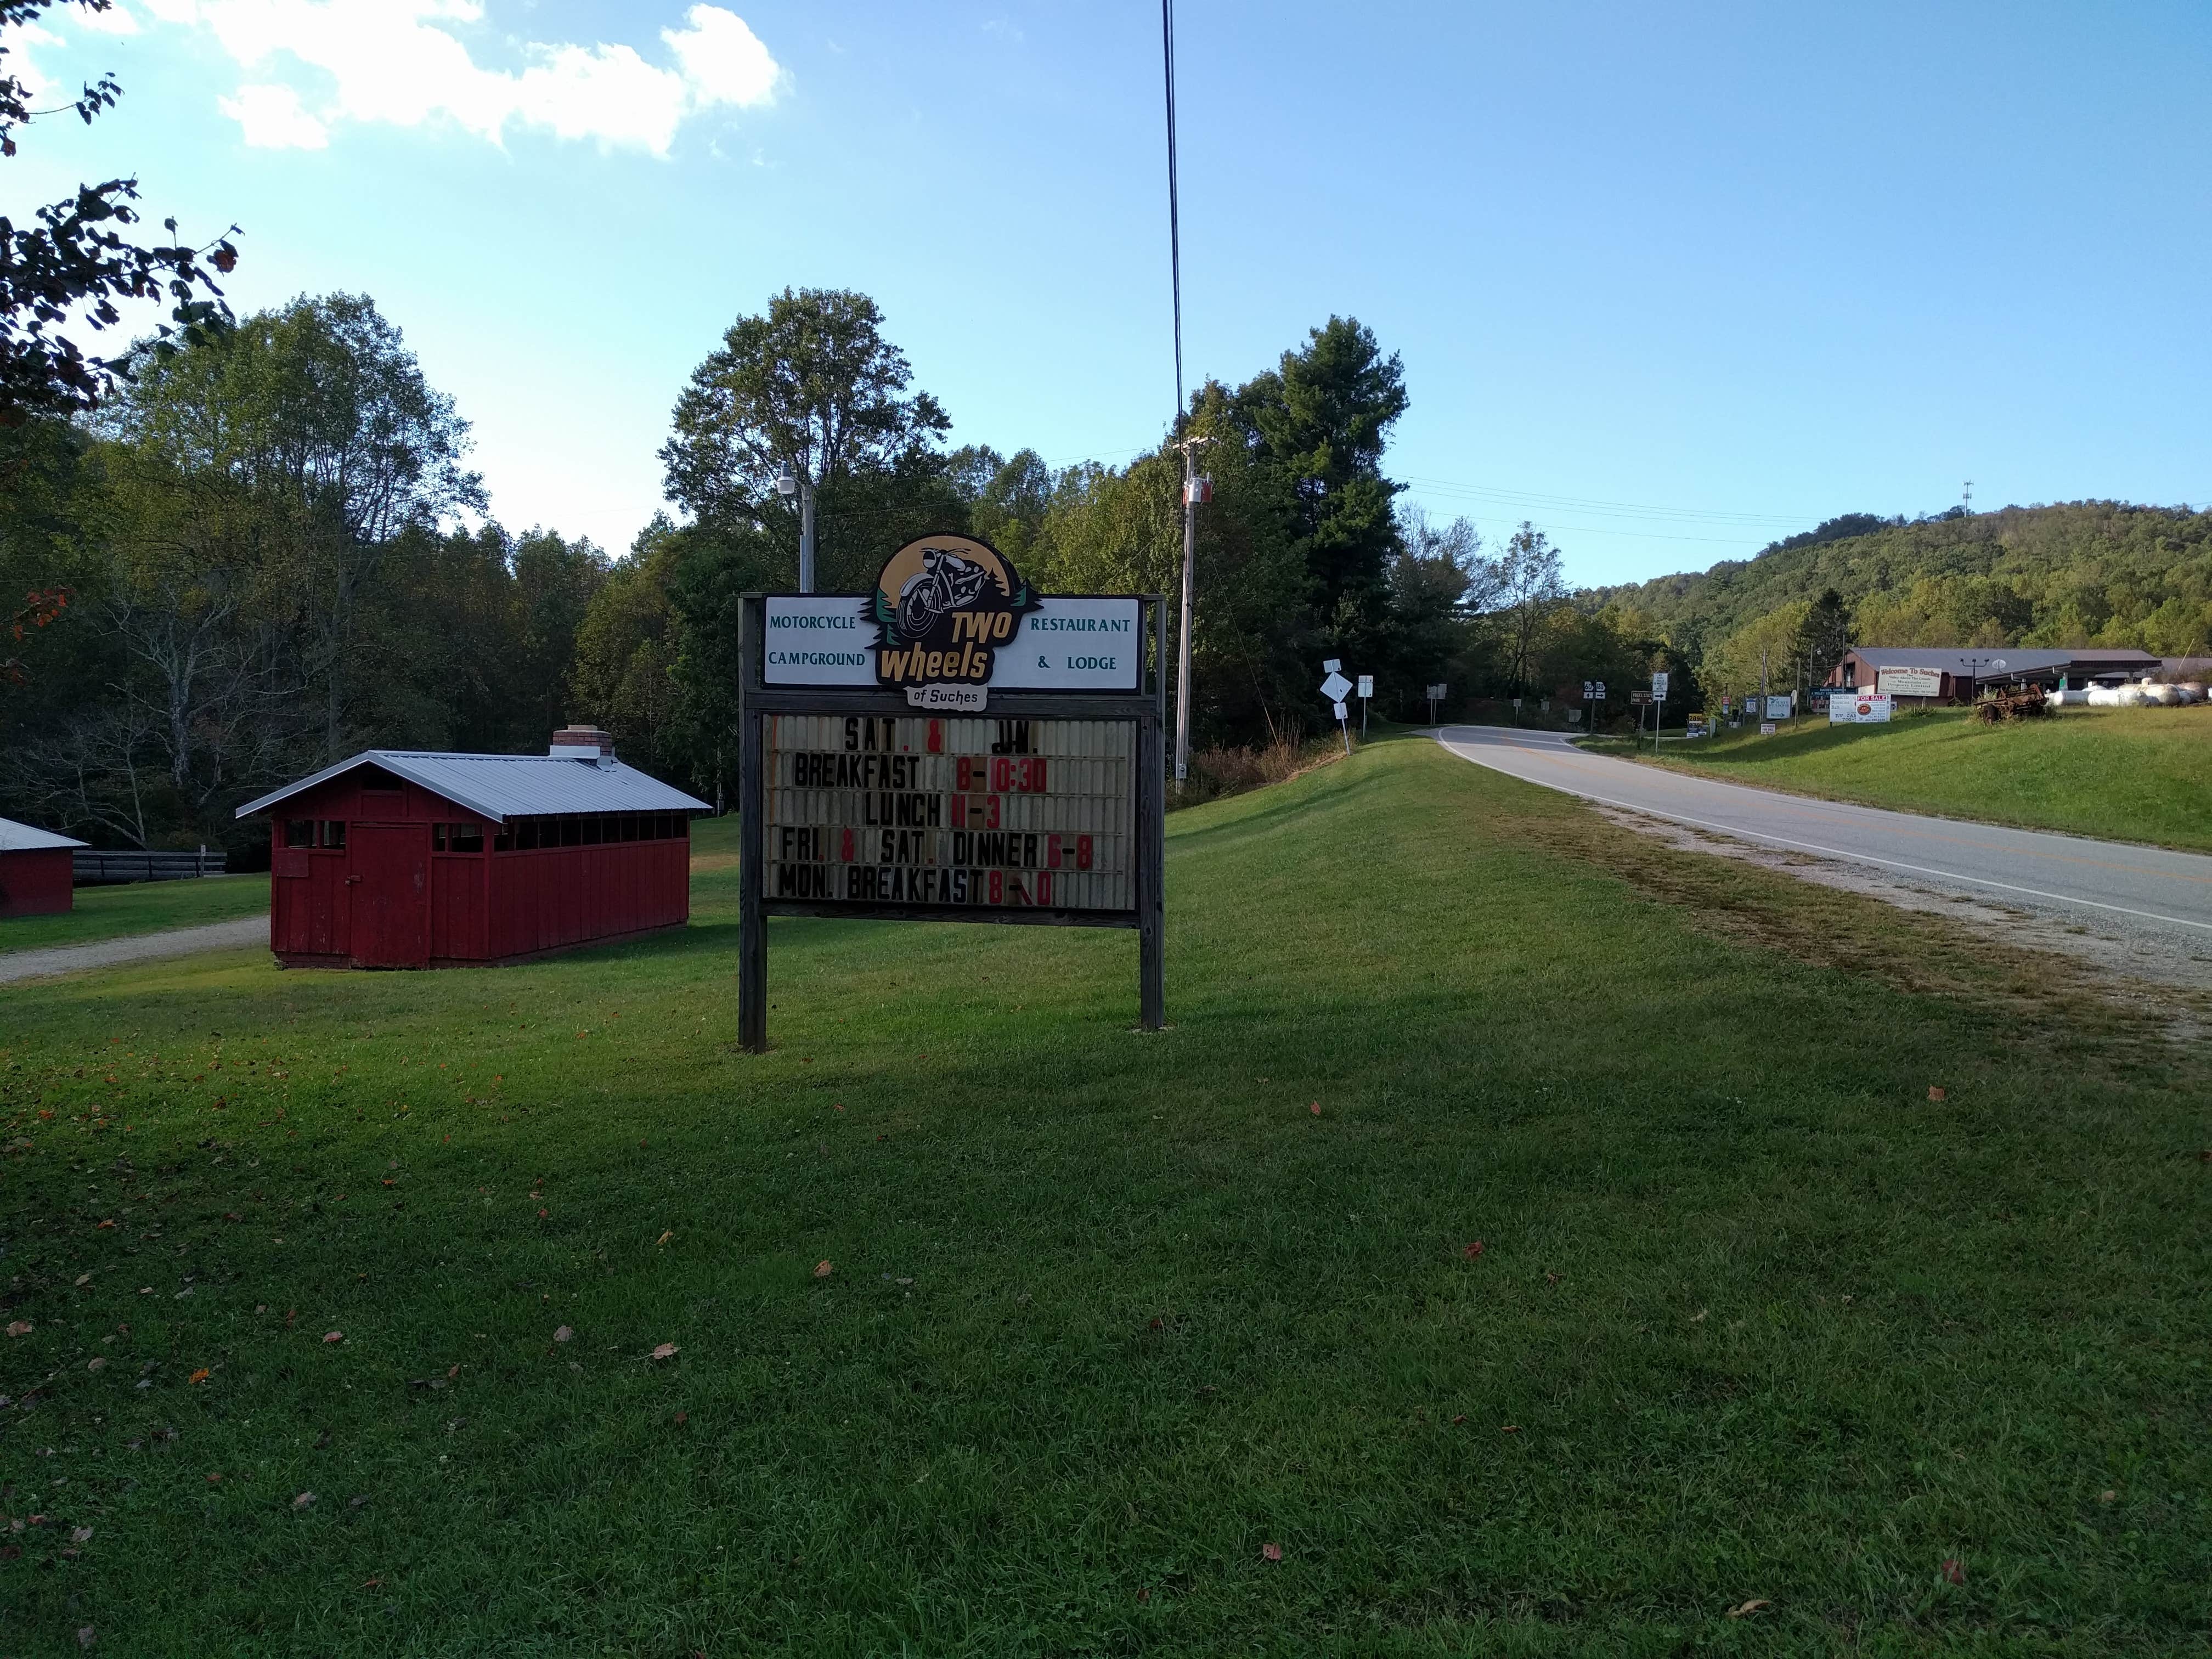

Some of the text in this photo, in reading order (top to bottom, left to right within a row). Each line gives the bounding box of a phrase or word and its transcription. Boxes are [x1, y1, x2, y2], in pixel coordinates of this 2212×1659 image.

[770, 616, 856, 629] MOTORCYCLE
[952, 612, 1012, 644] TWO
[1031, 618, 1130, 632] RESTAURANT
[769, 652, 865, 665] CAMPGROUND
[1038, 656, 1117, 669] & LODGE
[1920, 669, 1940, 678] Suches
[914, 690, 978, 705] of Suches
[928, 719, 941, 752] &
[795, 753, 920, 789] BREAKFAST
[866, 792, 940, 827] LUNCH
[782, 826, 824, 861] FRI.
[842, 829, 854, 861] &
[953, 831, 1037, 867] DINNER
[1048, 834, 1092, 869] 6-8
[779, 864, 833, 897] MON.
[848, 866, 983, 903] BREAKFAST
